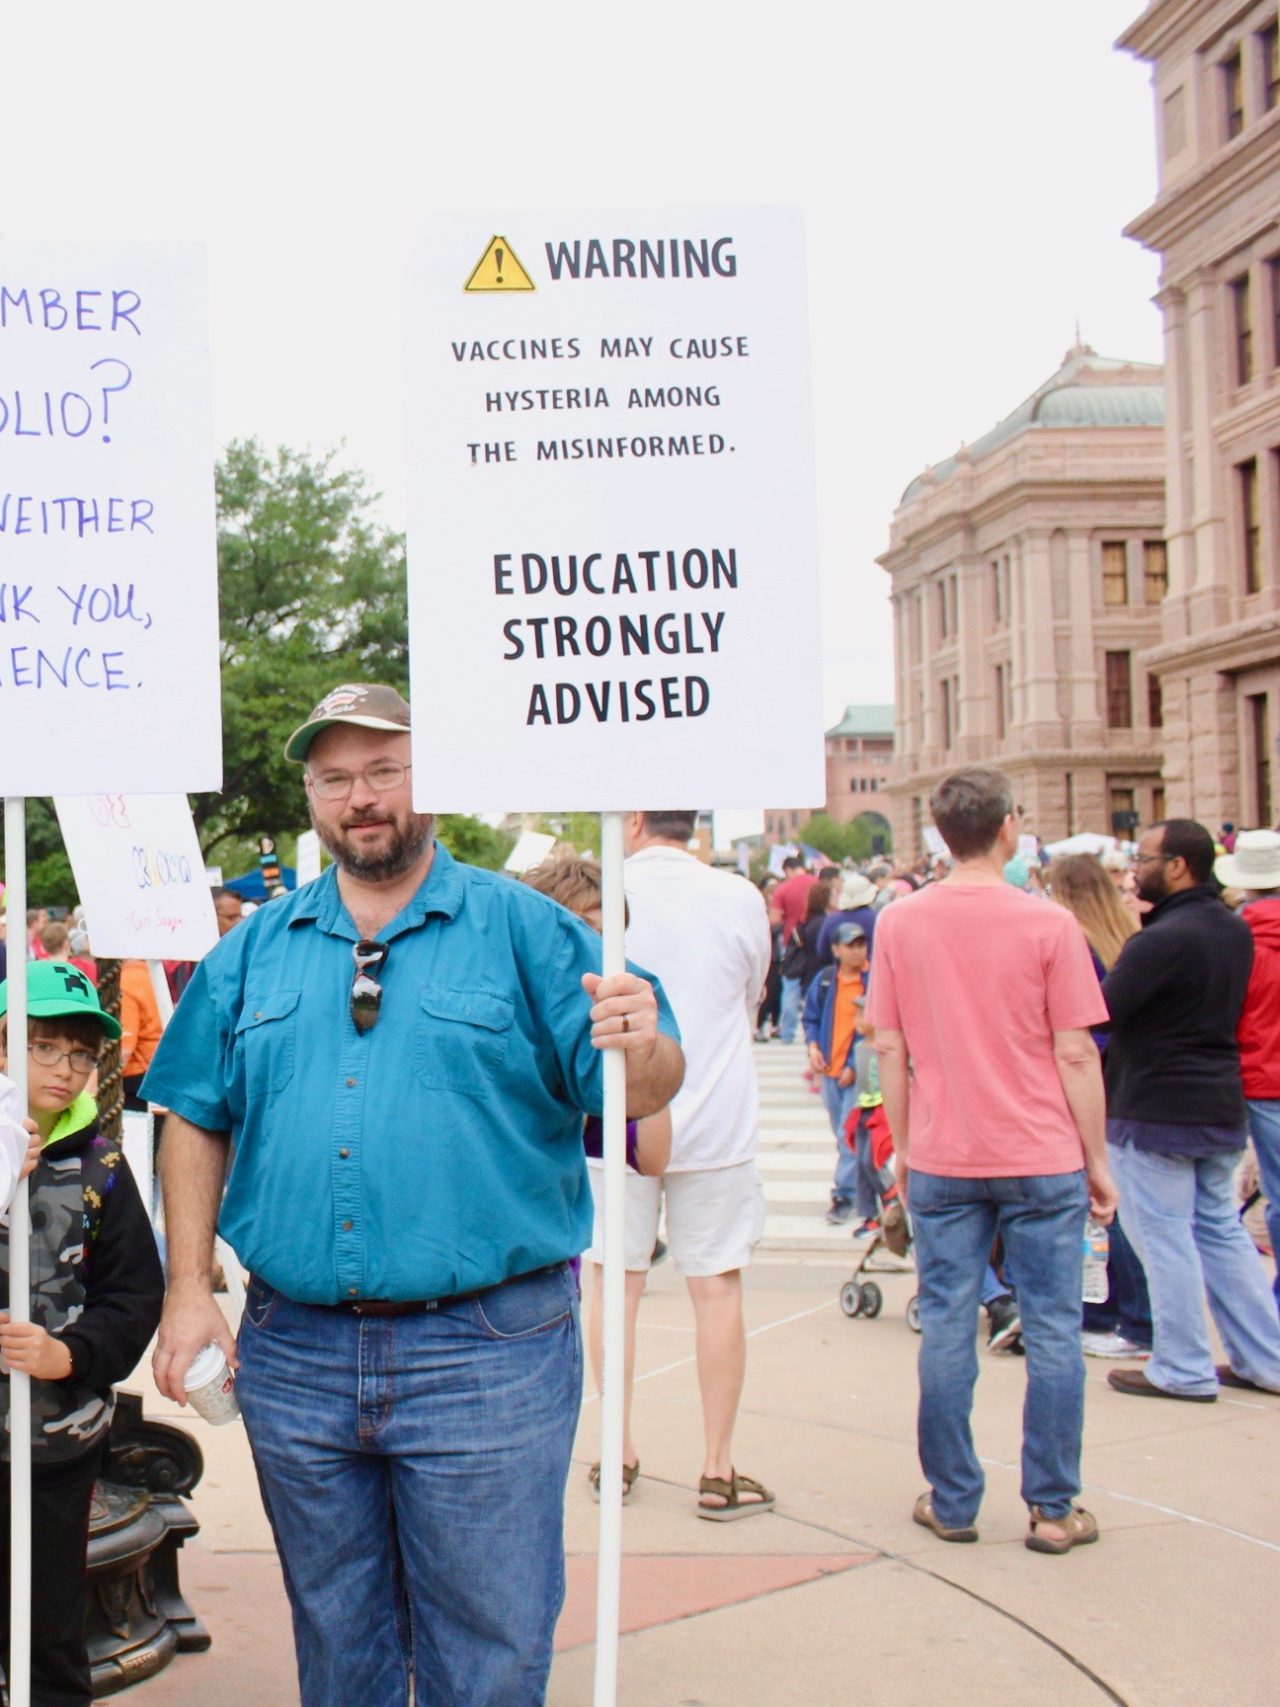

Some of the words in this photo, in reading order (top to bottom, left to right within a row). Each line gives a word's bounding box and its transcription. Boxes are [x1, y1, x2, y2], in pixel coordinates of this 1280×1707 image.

[545, 237, 737, 280] WARNING
[451, 337, 581, 362] VACCINES
[600, 336, 654, 359] MAY
[669, 336, 750, 359] CAUSE
[485, 387, 609, 412] HYSTERIA
[627, 386, 720, 409] AMONG
[467, 440, 517, 466] THE
[536, 433, 736, 461] MISINFORMED.
[493, 547, 738, 596] EDUCATION
[57, 583, 153, 629] YOU,
[503, 611, 725, 660] STRONGLY
[526, 675, 710, 725] ADVISED
